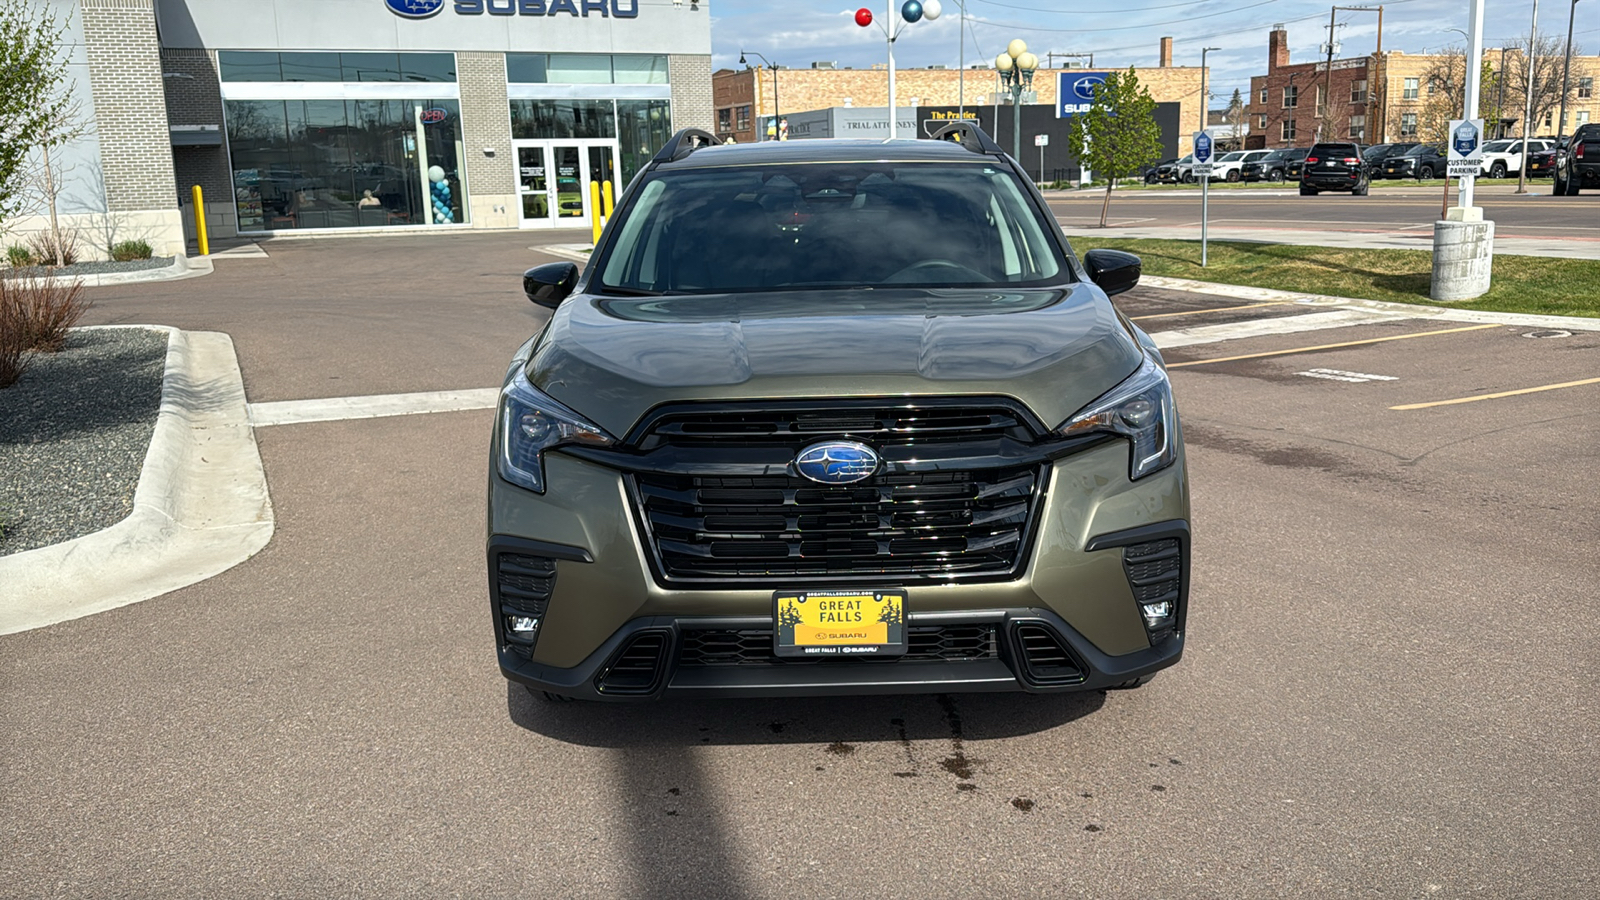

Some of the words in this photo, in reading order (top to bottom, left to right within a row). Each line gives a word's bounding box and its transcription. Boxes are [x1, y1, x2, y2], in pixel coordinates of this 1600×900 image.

[1064, 103, 1114, 113] SUBU
[420, 110, 445, 121] OPEN
[931, 111, 946, 120] The
[947, 110, 976, 119] Pratice
[872, 121, 917, 129] ATTNEYS
[819, 601, 862, 610] GREAT
[819, 612, 862, 622] FALLS
